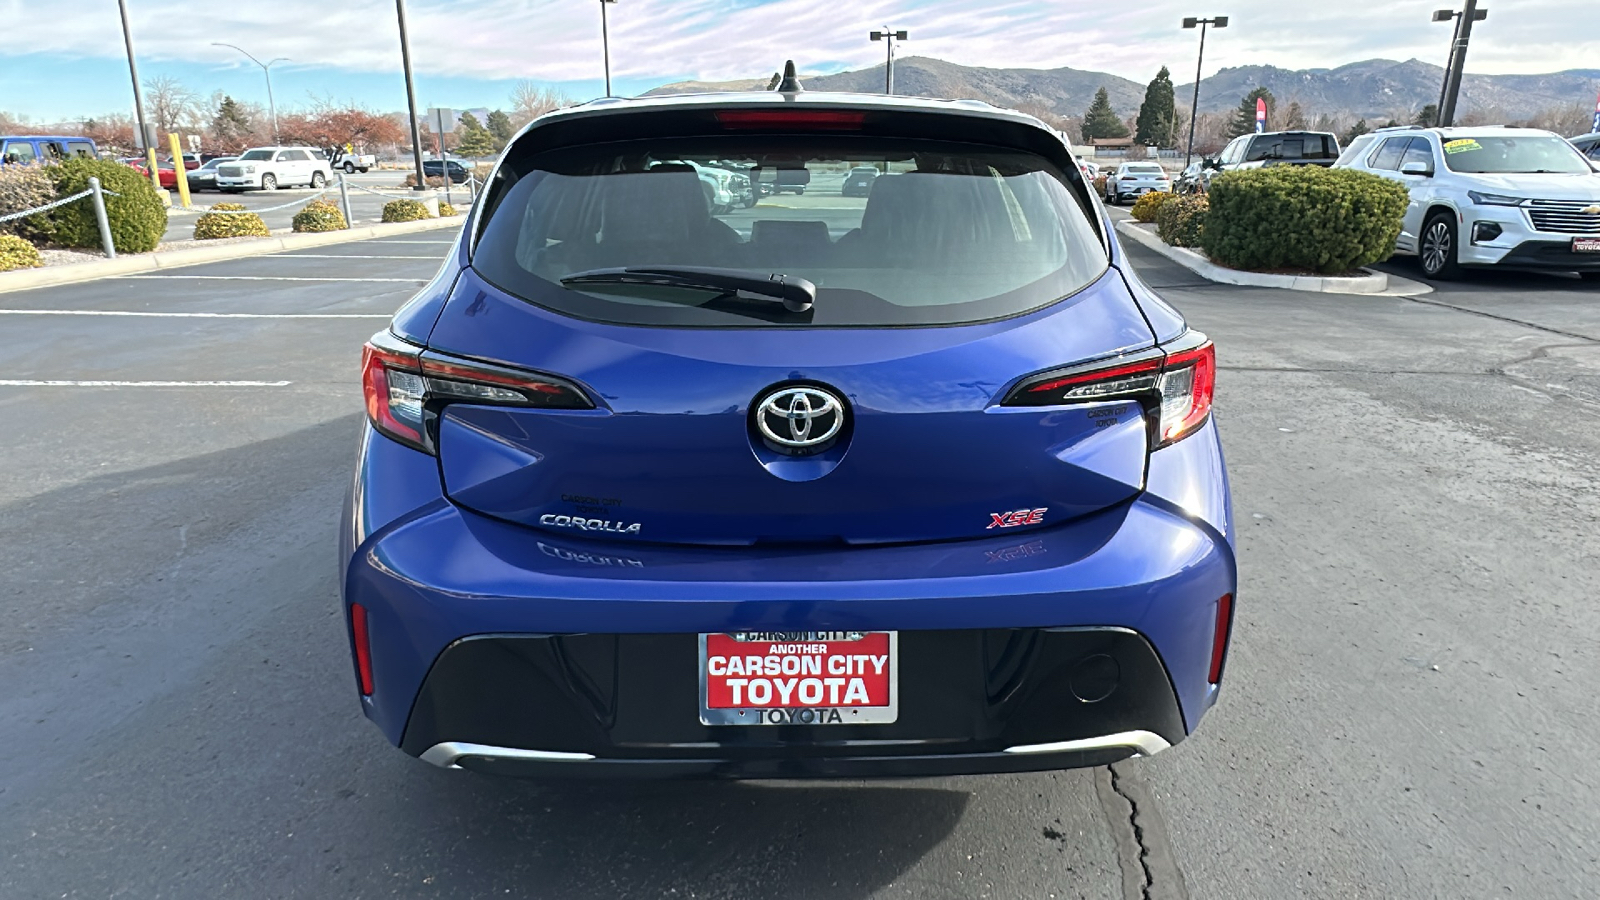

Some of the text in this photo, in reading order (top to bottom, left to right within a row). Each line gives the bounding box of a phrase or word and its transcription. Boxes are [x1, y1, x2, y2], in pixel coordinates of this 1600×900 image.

[561, 493, 622, 507] CARSON CITY
[540, 513, 641, 535] COROLLA
[986, 507, 1048, 529] XSE
[747, 631, 848, 641] CARSON CITY
[769, 644, 827, 654] ANOTHER
[708, 655, 888, 676] CARSON CITY
[726, 678, 870, 705] TOYOTA
[755, 708, 842, 724] TOYOTA
